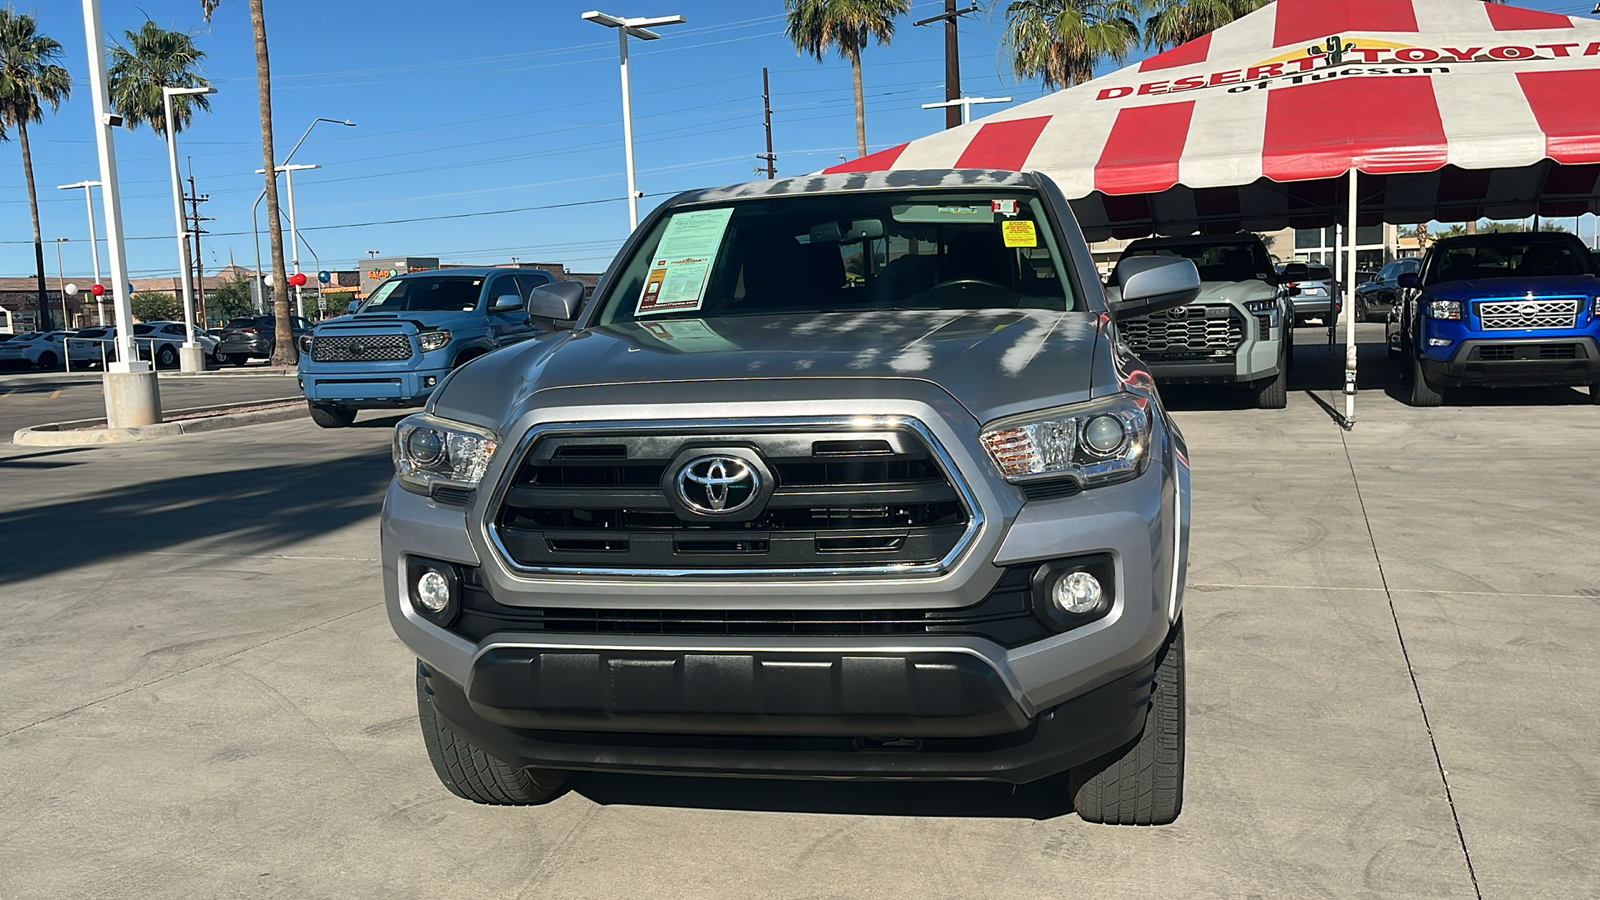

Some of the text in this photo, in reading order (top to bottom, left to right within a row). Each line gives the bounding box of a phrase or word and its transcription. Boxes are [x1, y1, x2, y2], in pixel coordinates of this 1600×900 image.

[1096, 53, 1328, 101] DESERT
[1227, 66, 1451, 94] of Tucson
